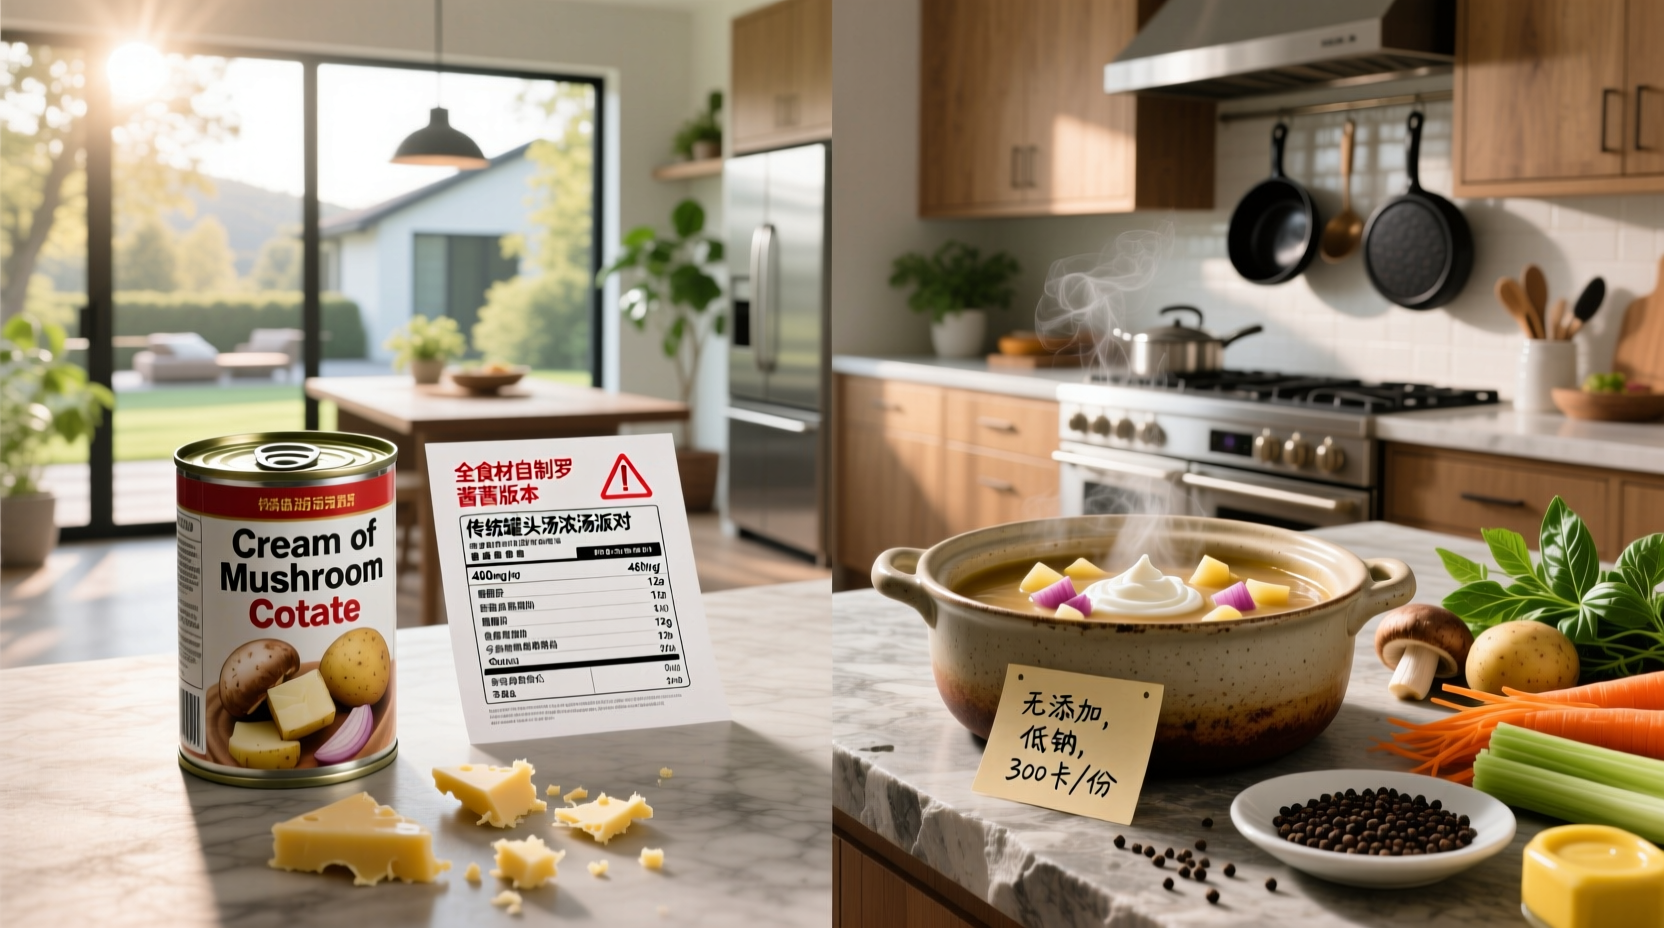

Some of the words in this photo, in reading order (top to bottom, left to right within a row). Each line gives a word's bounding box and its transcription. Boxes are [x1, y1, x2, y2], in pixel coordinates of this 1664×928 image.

[454, 457, 573, 483] 全食材自制罗
[232, 528, 341, 559] Cream
[350, 517, 377, 550] of
[220, 557, 383, 593] Mushroom
[249, 596, 361, 629] Cotate
[1021, 691, 1109, 731] 无添加，
[1019, 724, 1084, 760] 低钠，
[1005, 757, 1118, 798] 300卡/份
